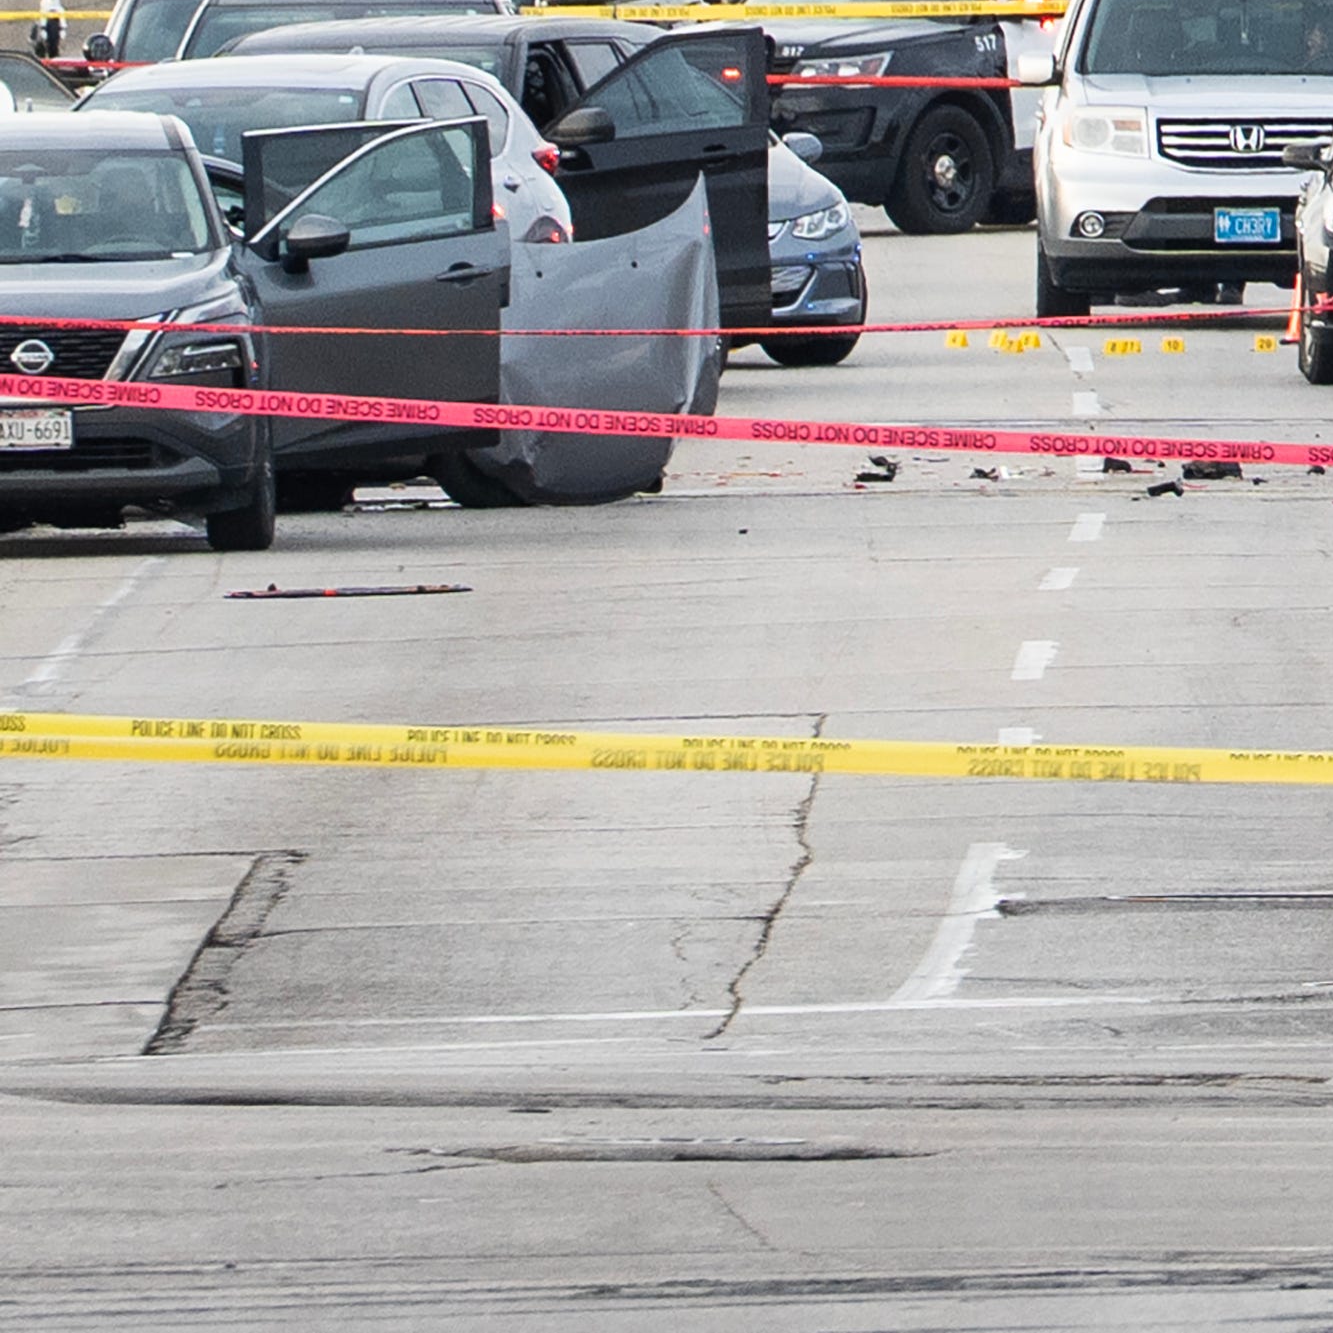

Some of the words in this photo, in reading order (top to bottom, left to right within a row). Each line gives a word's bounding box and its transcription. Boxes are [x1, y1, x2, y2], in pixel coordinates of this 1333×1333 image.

[974, 35, 997, 52] 517
[18, 379, 42, 397] DO
[47, 381, 102, 401] SCENE
[108, 384, 160, 404] CRIME
[195, 390, 253, 410] CROSS
[260, 394, 292, 412] NOT
[296, 396, 320, 414] DO
[326, 397, 382, 418] SCENE
[386, 401, 440, 421] CRIME
[474, 407, 532, 426] CROSS
[538, 410, 570, 428] NOT
[575, 412, 599, 429] DO
[605, 414, 660, 433] SCENE
[665, 417, 717, 436] CRIME
[752, 422, 810, 440] CROSS
[816, 425, 849, 442] NOT
[853, 426, 878, 444] DO
[884, 428, 938, 447] SCENE
[944, 431, 996, 450] CRIME
[1030, 435, 1088, 453] CROSS
[1095, 438, 1128, 455] NOT
[1132, 439, 1156, 456] DO
[1162, 440, 1217, 458] SCENE
[1222, 443, 1274, 460] CRIME
[0, 715, 26, 732] OSS
[131, 719, 172, 738] POLICE
[178, 720, 203, 738] LINE
[210, 721, 227, 739] DO
[230, 722, 254, 739] NOT
[260, 723, 301, 740] CROSS
